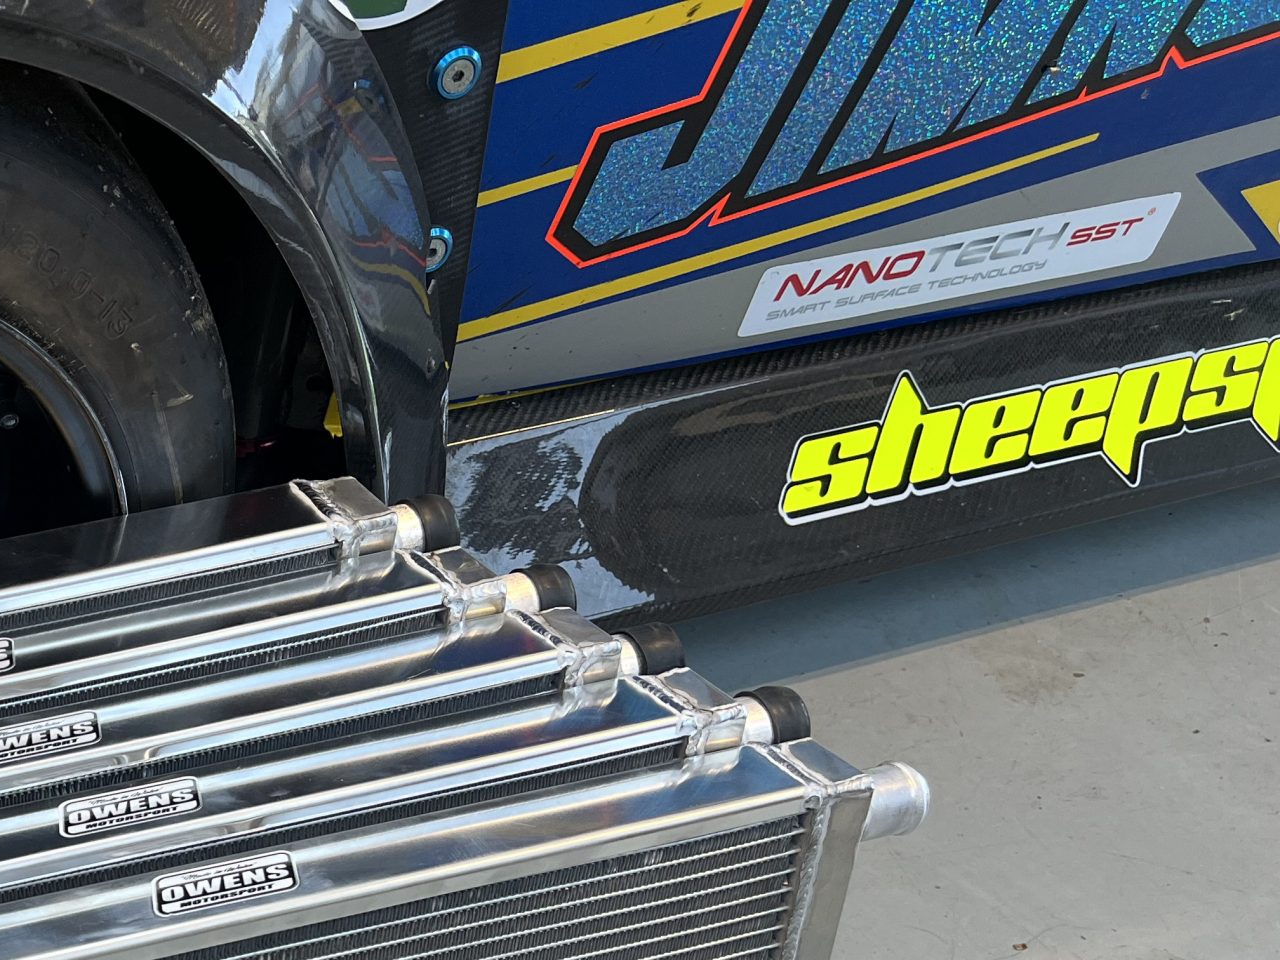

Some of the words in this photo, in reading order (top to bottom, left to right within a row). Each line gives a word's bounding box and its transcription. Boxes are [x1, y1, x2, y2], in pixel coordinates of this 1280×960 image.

[766, 299, 831, 321] SMART
[834, 283, 922, 309] SURFACE
[927, 260, 1048, 290] TECHNOLOGY
[68, 788, 194, 824] OWENS
[86, 806, 179, 829] MOTORSPORT
[161, 864, 289, 902] OWENS
[180, 884, 274, 908] MOTORSPORT
